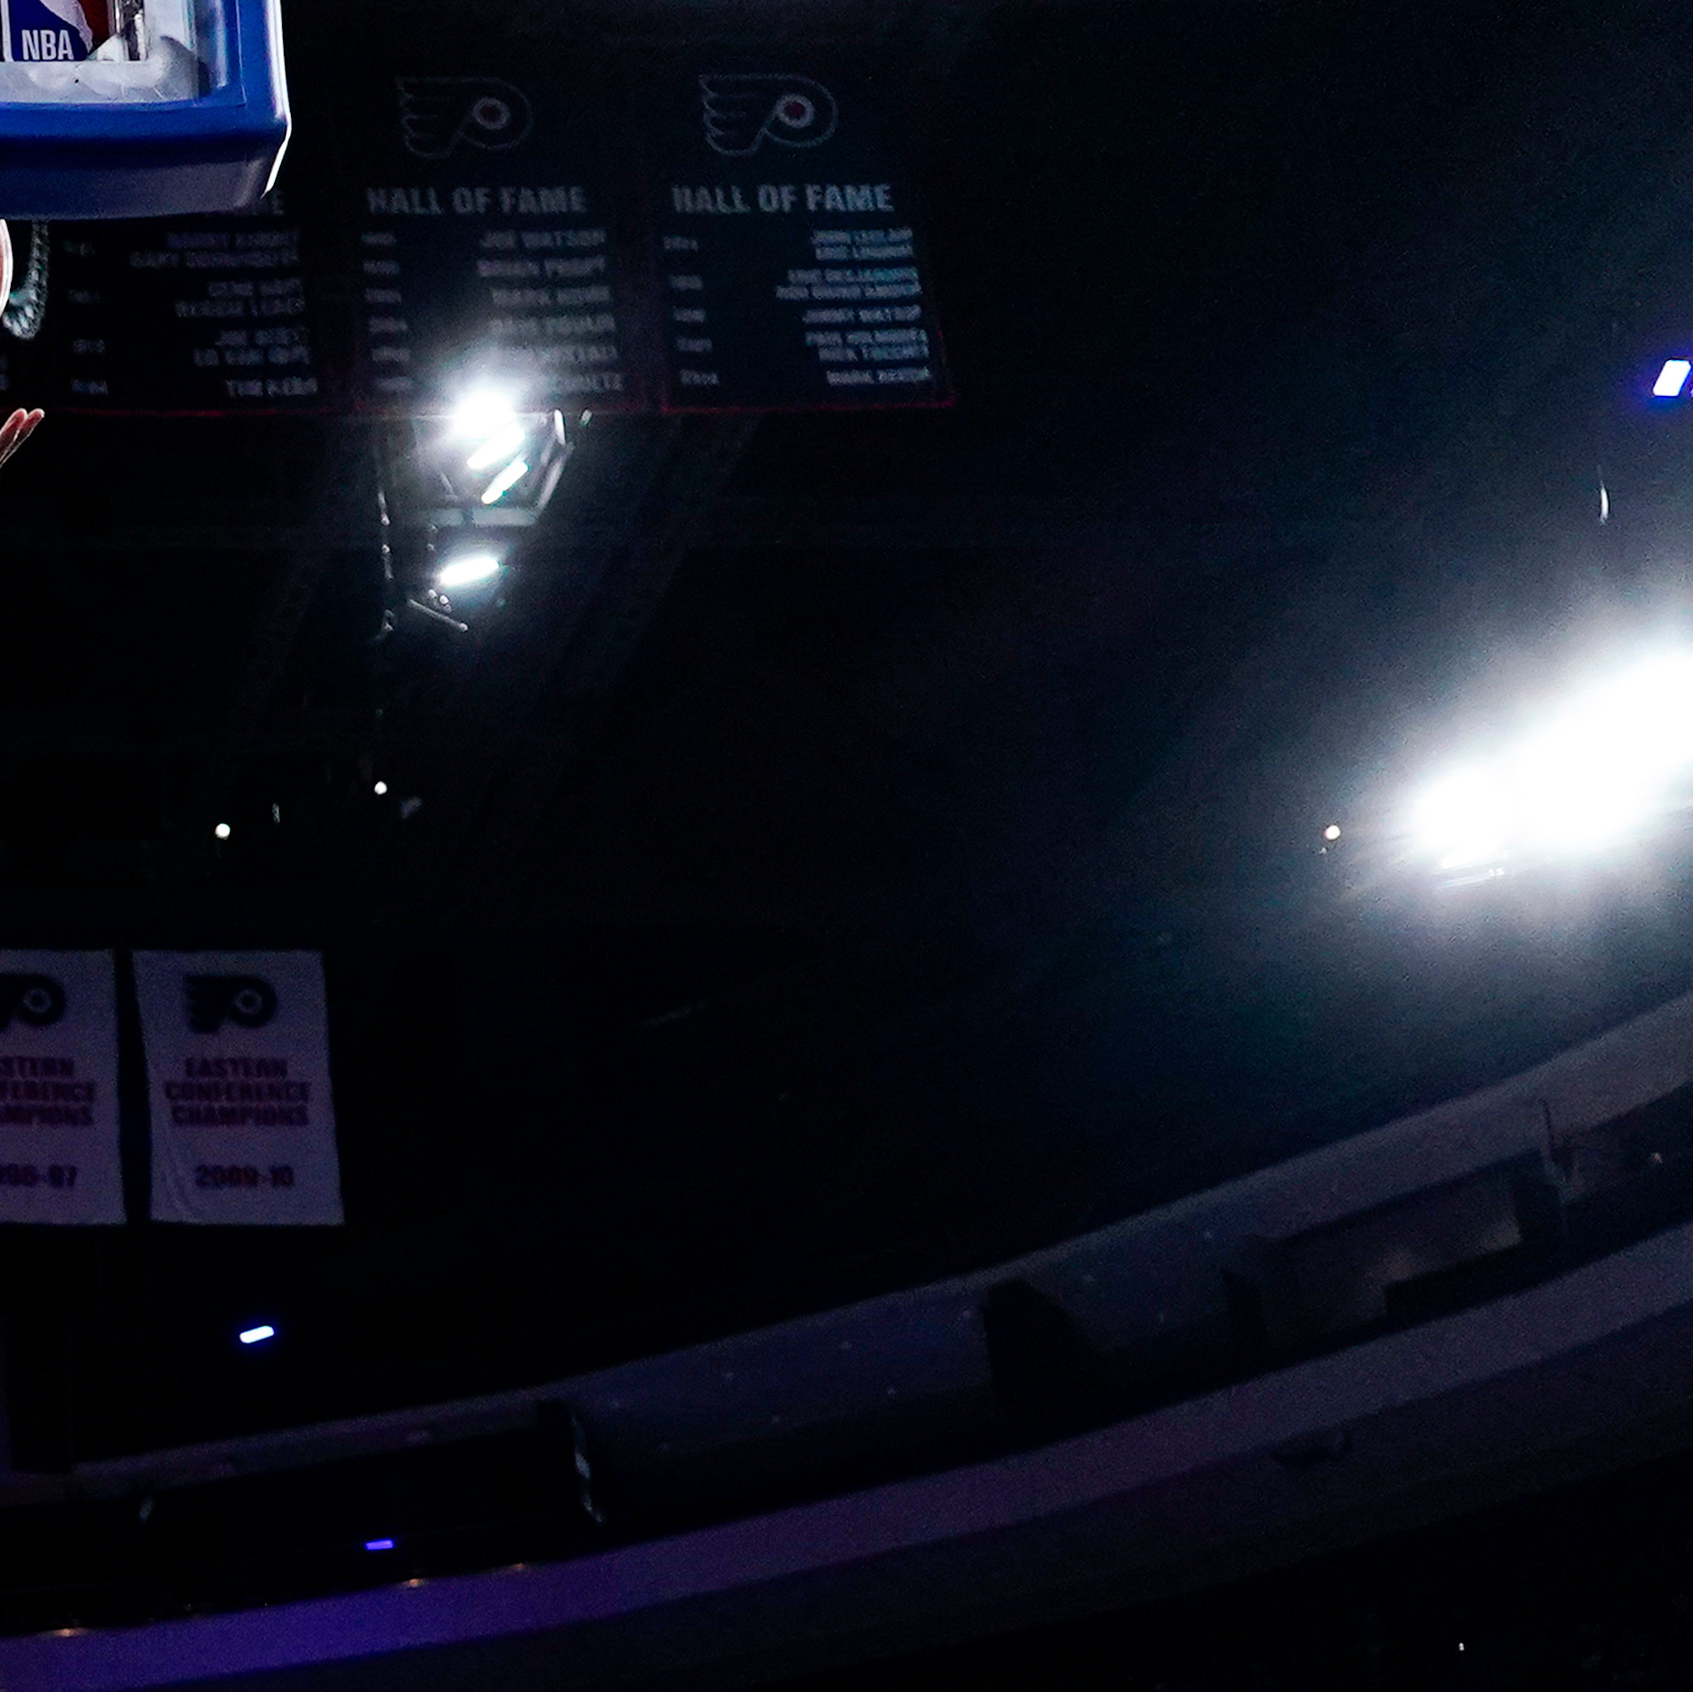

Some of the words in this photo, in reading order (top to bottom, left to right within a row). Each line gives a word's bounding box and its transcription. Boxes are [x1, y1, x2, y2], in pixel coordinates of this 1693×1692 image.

[21, 29, 74, 61] NBA
[366, 186, 444, 215] HALL
[452, 186, 491, 214] OF
[500, 186, 588, 214] FAME
[671, 184, 751, 214] HALL
[757, 183, 797, 213] OF
[804, 183, 895, 212] FAME
[185, 1056, 288, 1078] EASTERN
